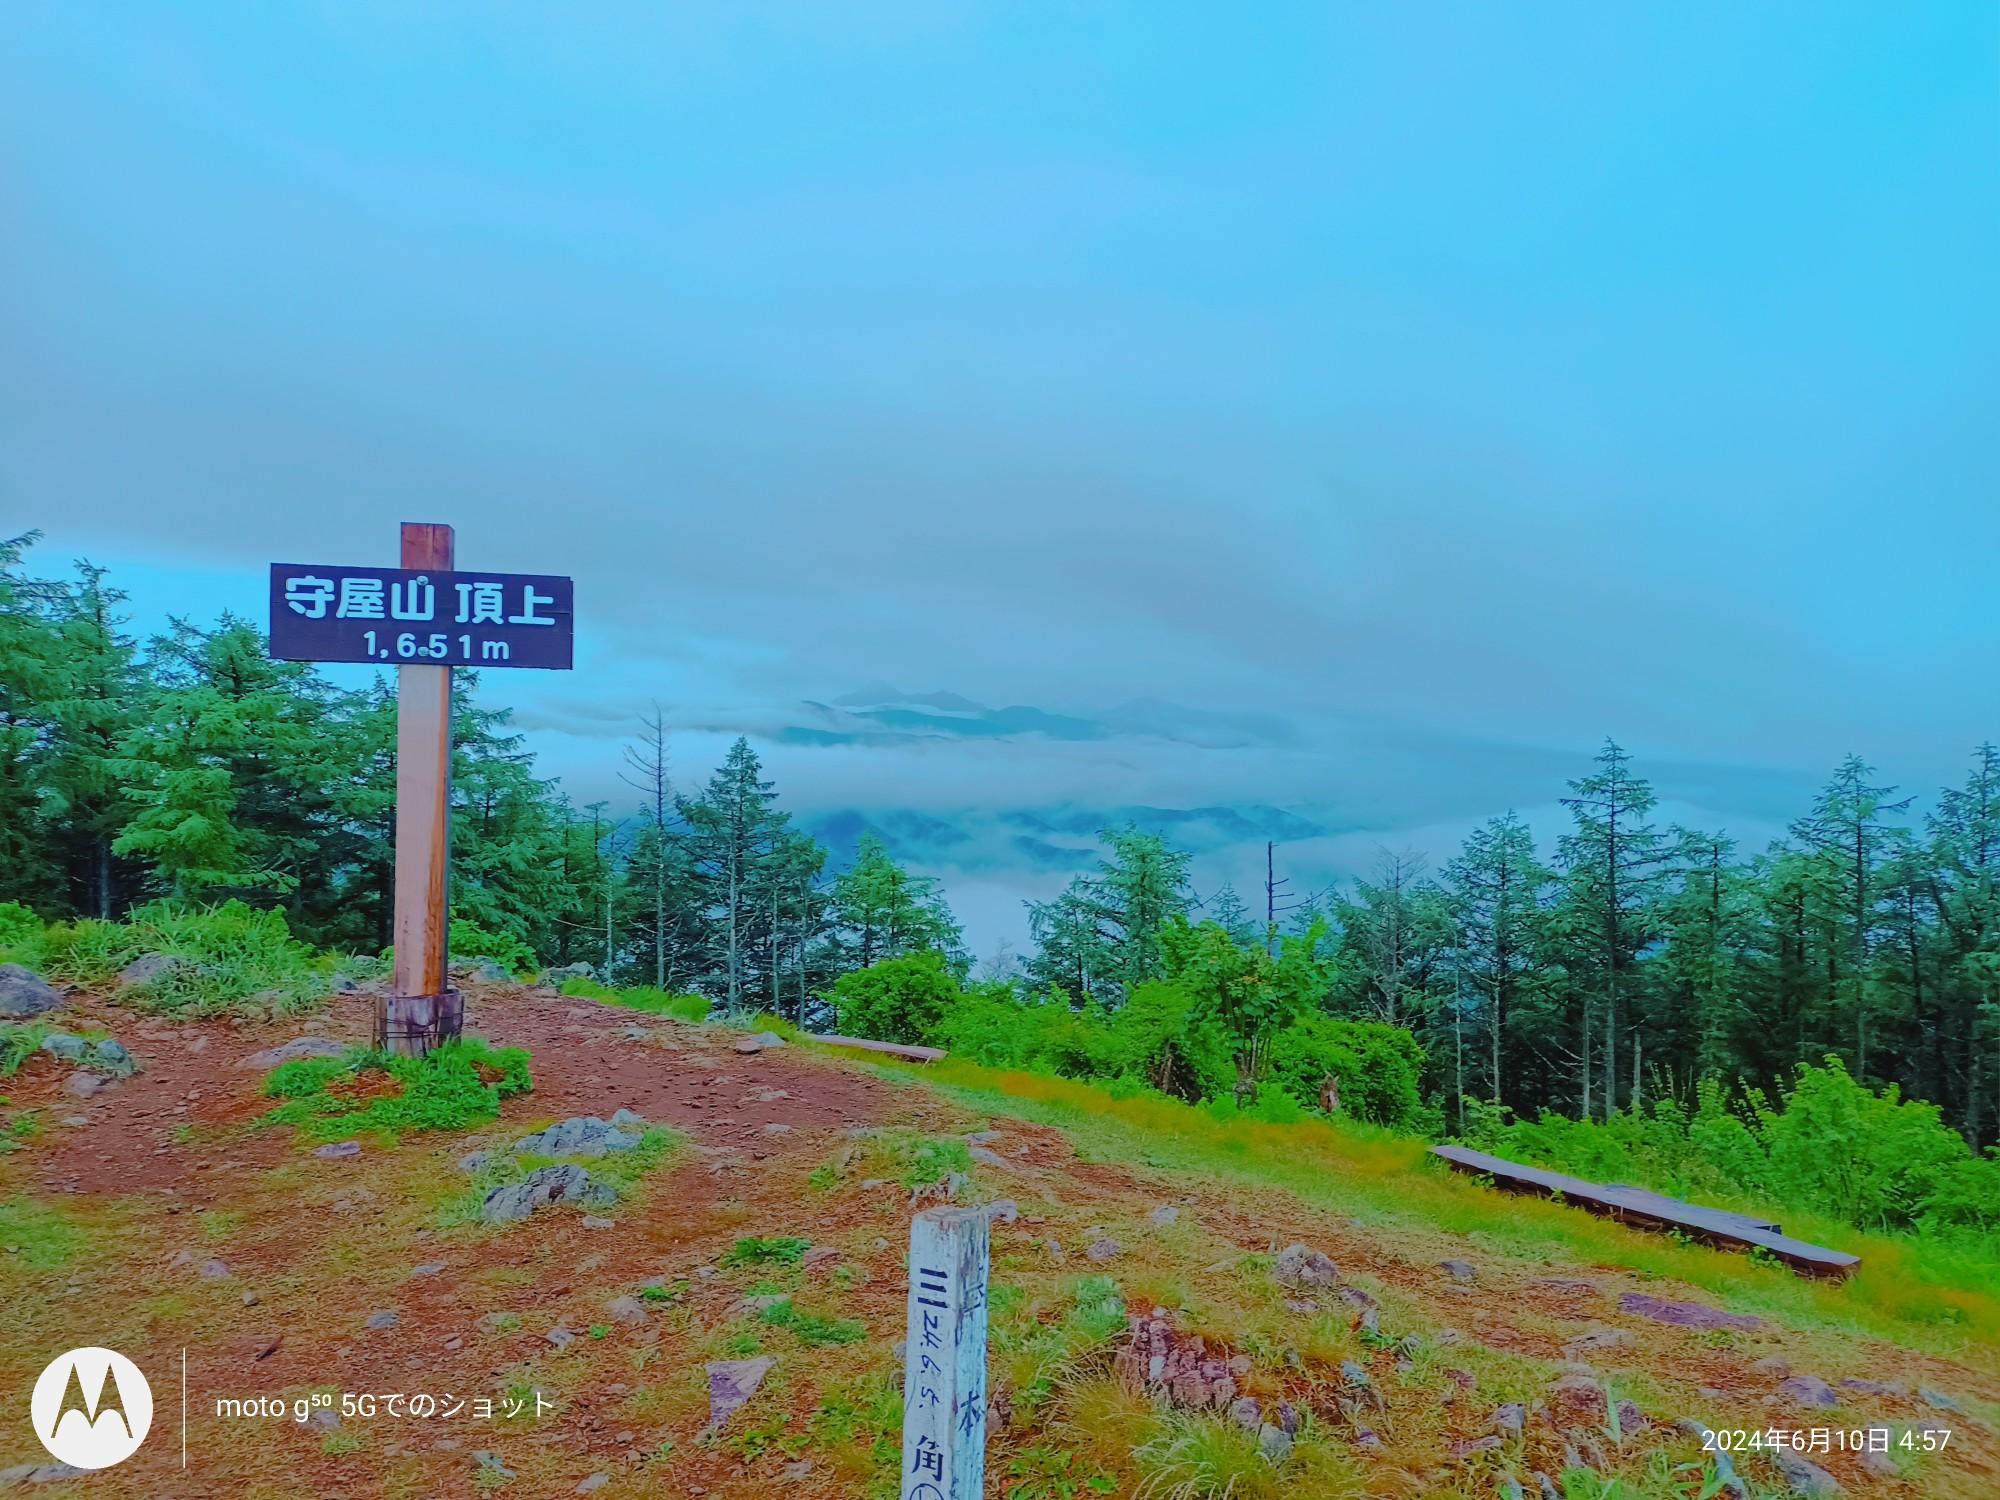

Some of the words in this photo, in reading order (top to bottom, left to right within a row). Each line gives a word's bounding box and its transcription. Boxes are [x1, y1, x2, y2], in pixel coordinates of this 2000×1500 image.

[284, 575, 435, 621] 守屋山
[454, 582, 556, 626] 頂上
